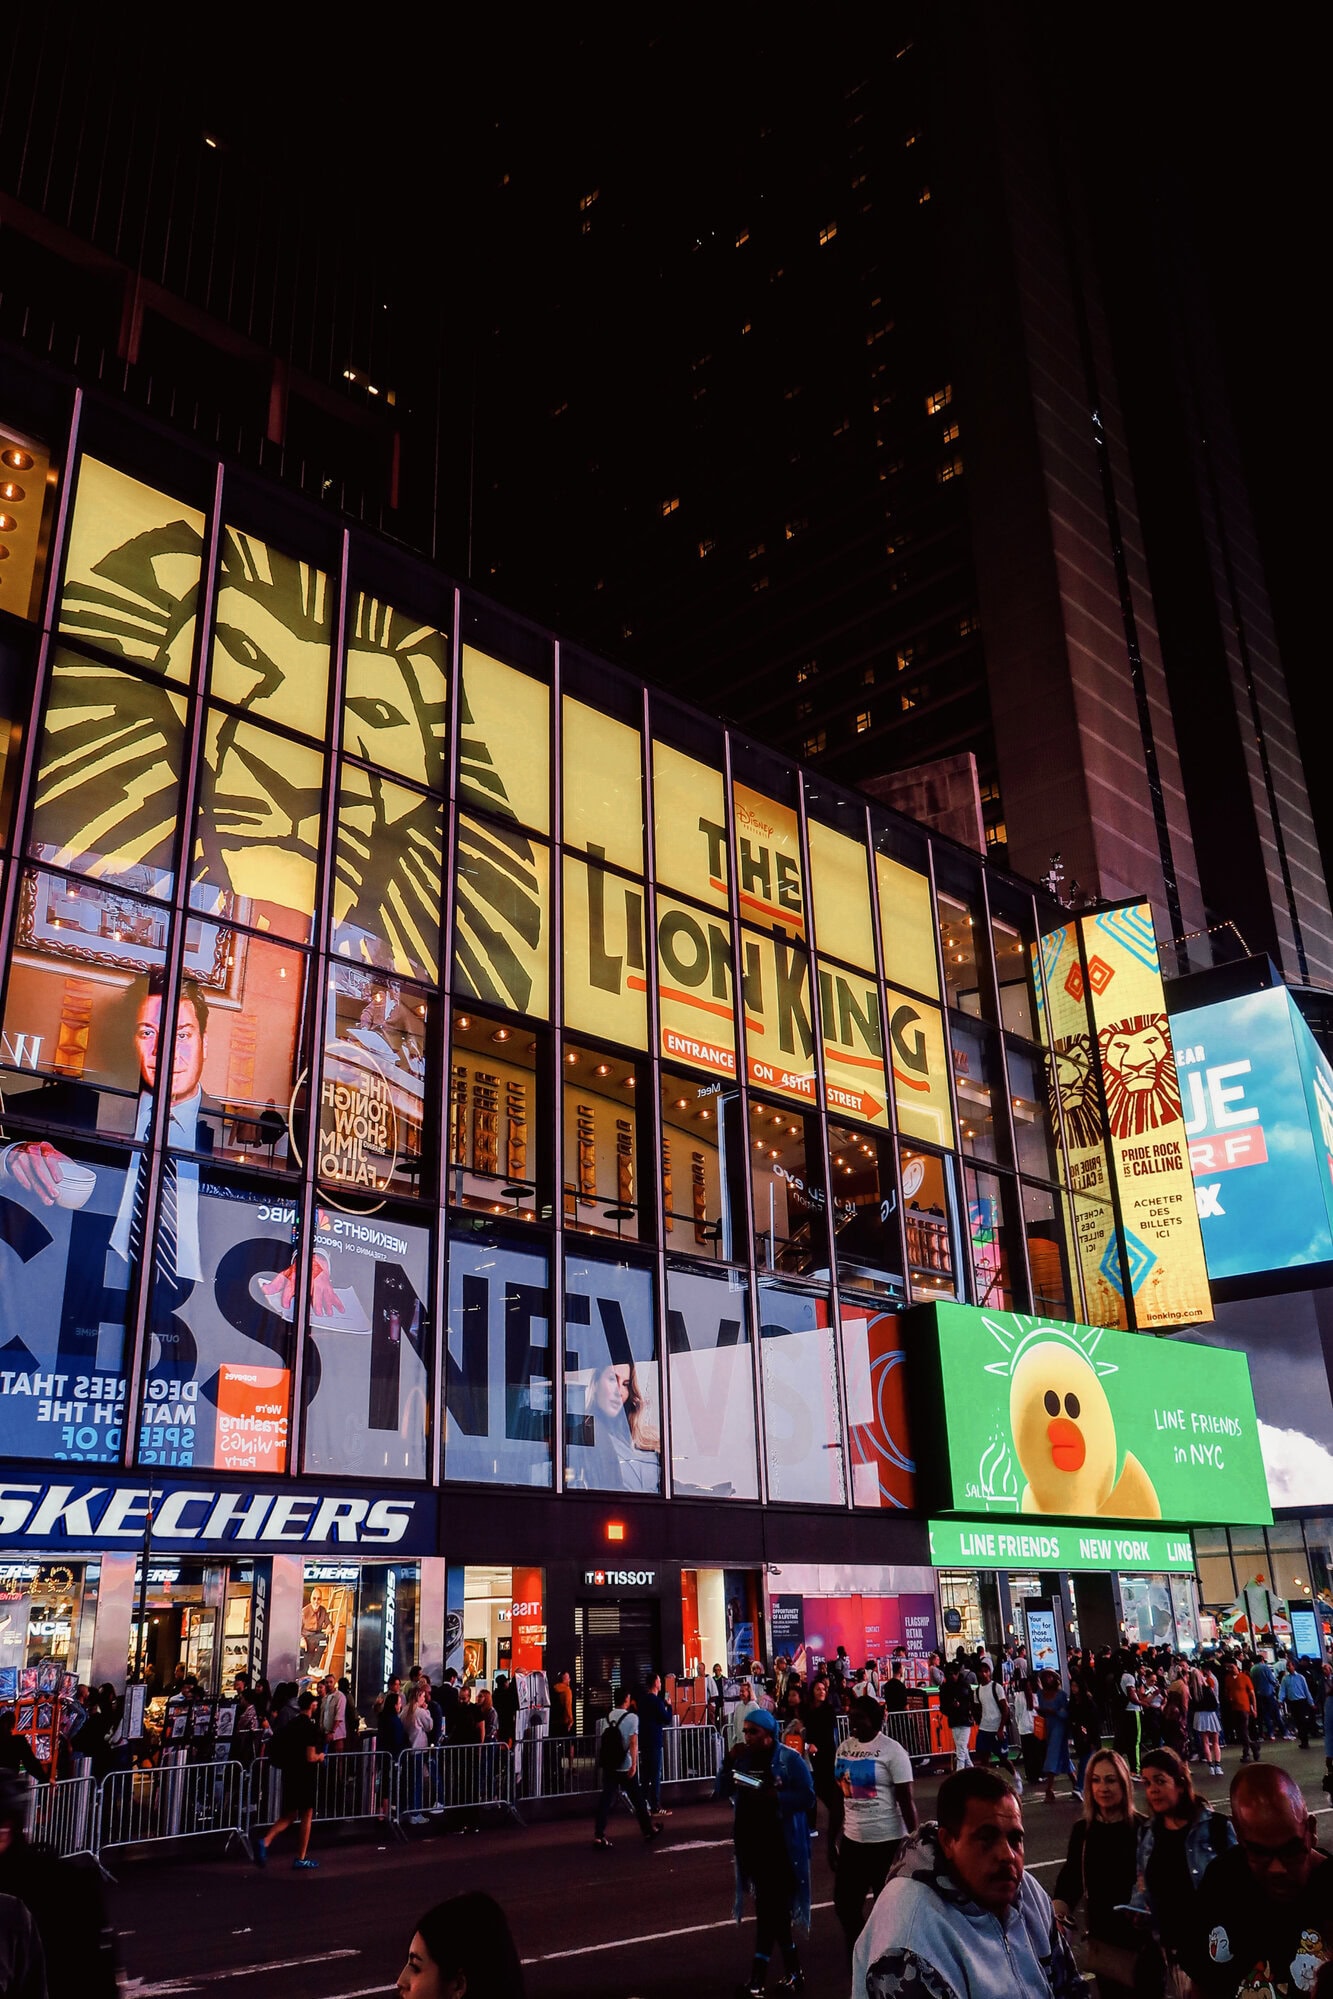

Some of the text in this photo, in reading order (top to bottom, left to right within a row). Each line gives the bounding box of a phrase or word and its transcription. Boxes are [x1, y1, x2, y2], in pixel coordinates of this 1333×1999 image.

[699, 817, 802, 914] THE
[587, 841, 929, 1074] LION KING
[1175, 1045, 1206, 1067] EAR
[667, 1034, 862, 1111] ENTRANCE ON 45TH STREET
[1121, 1141, 1181, 1162] PRIDE ROCK
[1188, 1135, 1252, 1170] RF
[1123, 1155, 1183, 1177] IS CALLING
[1133, 1194, 1183, 1209] ACHETER
[1140, 1218, 1183, 1230] BILLETS
[1149, 1208, 1170, 1218] DES
[1156, 1231, 1170, 1239] ICI
[1146, 1309, 1203, 1321] lionking.com
[1154, 1408, 1243, 1437] LINE FRIENDS
[1174, 1443, 1225, 1470] in NYC
[0, 1484, 416, 1544] SKECHERS
[960, 1533, 996, 1557] LINE
[998, 1534, 1060, 1559] FRIENDS
[1080, 1538, 1111, 1560] NEW
[1114, 1540, 1150, 1561] YORK
[1167, 1542, 1193, 1562] LINE
[605, 1571, 656, 1586] TISSOT
[250, 1574, 266, 1690] SKECH
[383, 1568, 396, 1693] SKECHE
[904, 1616, 930, 1627] FLAGSHIP
[906, 1628, 924, 1639] RETAIL
[906, 1640, 924, 1651] SPACE
